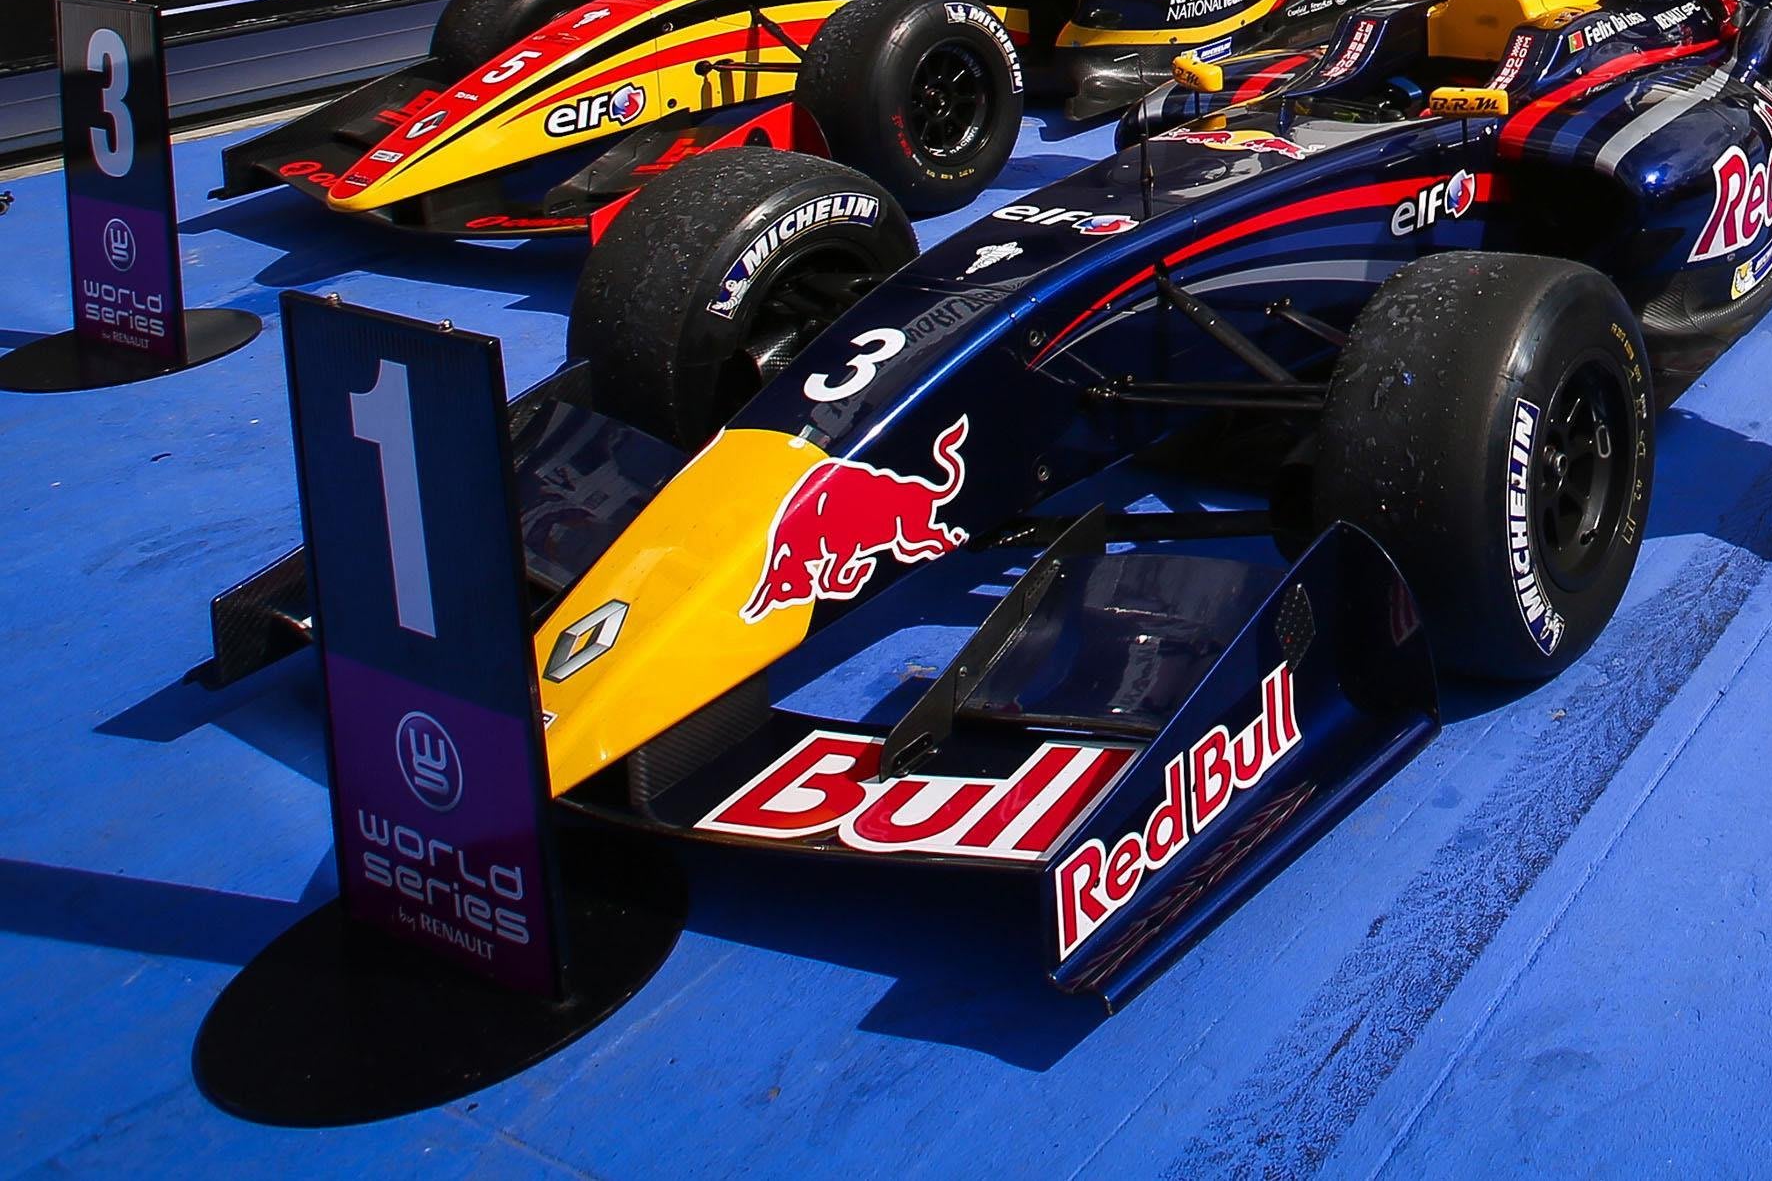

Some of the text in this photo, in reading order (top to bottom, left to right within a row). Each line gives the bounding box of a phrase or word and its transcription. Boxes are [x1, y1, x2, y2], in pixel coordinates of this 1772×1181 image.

[968, 6, 1024, 89] MICHELIN
[1583, 21, 1616, 47] Felix
[1610, 14, 1627, 33] Da
[481, 50, 543, 85] 5
[87, 27, 134, 178] 3
[546, 93, 610, 136] elf
[1430, 97, 1500, 111] B.R.M
[740, 195, 879, 276] MICHELIN
[991, 203, 1092, 228] elf
[1390, 181, 1448, 236] elf
[83, 279, 163, 314] world
[84, 303, 165, 337] series
[113, 330, 150, 349] RENAULT
[802, 327, 907, 403] 3
[350, 358, 437, 639] 1
[1506, 402, 1548, 633] MICHELIN
[694, 729, 1141, 863] Bull
[1054, 659, 1302, 962] Red Bull
[358, 808, 524, 901] world
[363, 850, 530, 946] series
[419, 911, 496, 961] RENAULT
